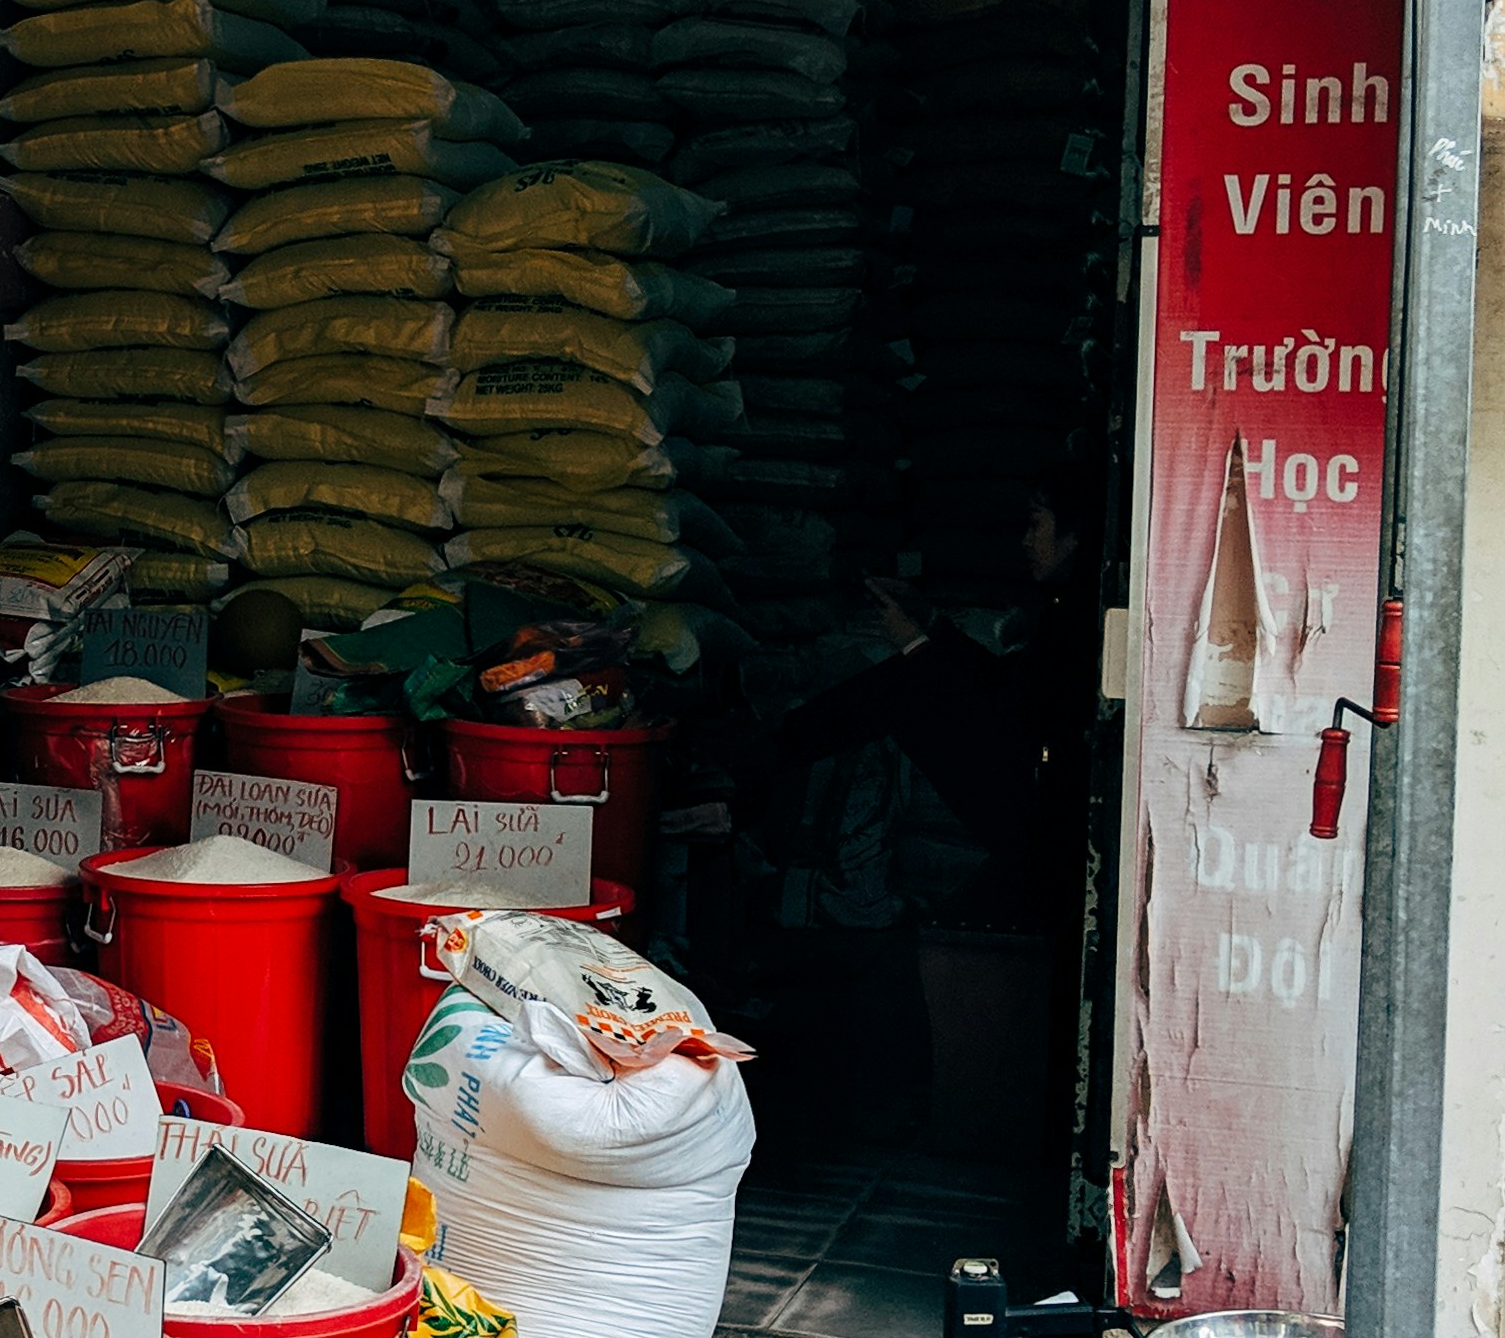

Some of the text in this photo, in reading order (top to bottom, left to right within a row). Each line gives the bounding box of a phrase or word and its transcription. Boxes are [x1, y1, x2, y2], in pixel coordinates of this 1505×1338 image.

[1228, 63, 1388, 127] Sinh
[1224, 173, 1385, 235] Viên
[1180, 329, 1388, 404] Trườn
[1241, 438, 1359, 514] Học
[240, 780, 292, 803] LOAN
[86, 1258, 154, 1314] SEN
